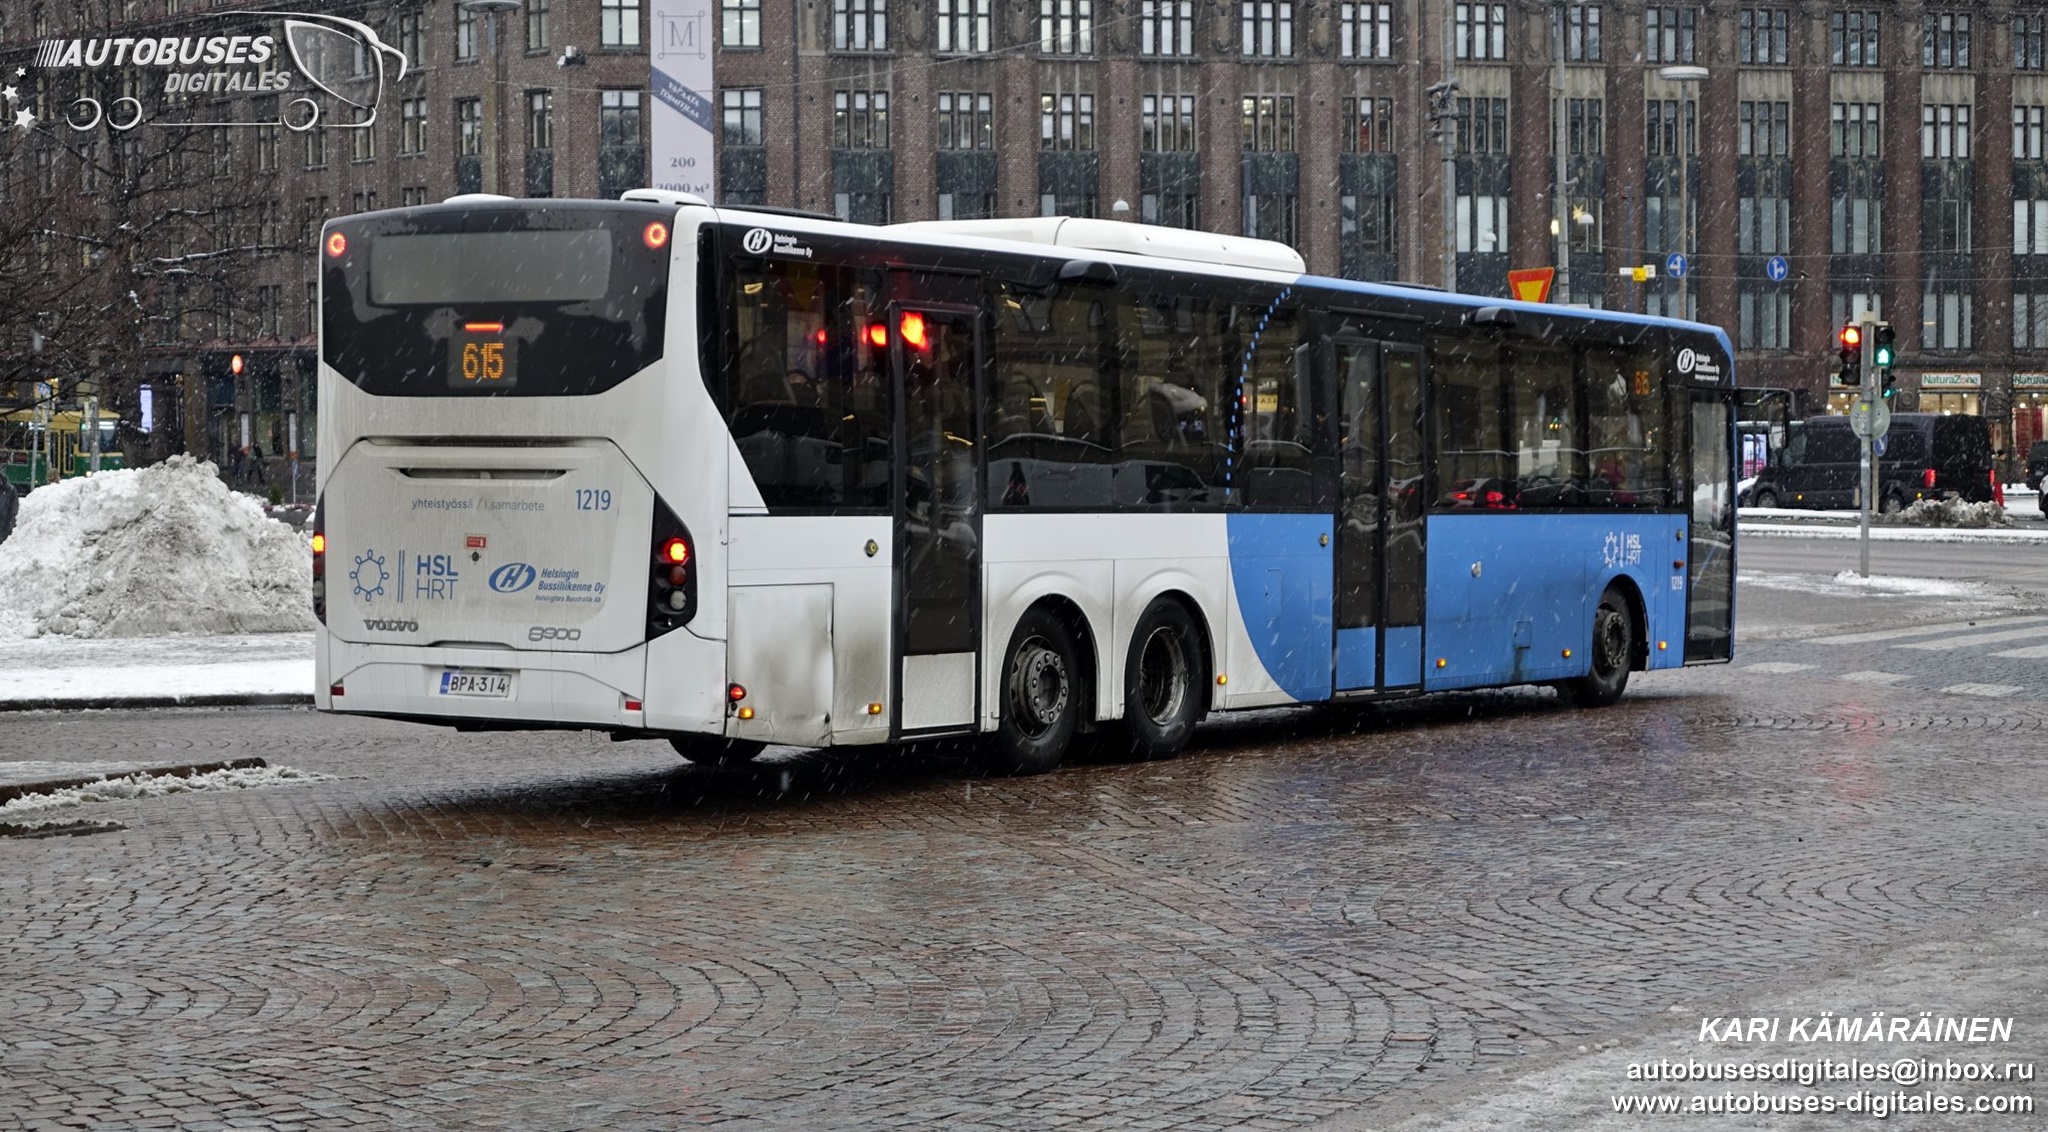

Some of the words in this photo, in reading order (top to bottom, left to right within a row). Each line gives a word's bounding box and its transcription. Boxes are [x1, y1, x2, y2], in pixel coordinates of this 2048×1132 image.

[669, 20, 695, 47] M
[670, 157, 696, 168] 200
[463, 343, 504, 379] 615
[1924, 373, 1979, 385] NaturaZone
[411, 498, 474, 510] yhteistyössä
[489, 501, 545, 511] samarbete
[576, 489, 611, 511] 1219
[1626, 534, 1642, 549] HSL
[1626, 549, 1642, 565] HRT
[417, 555, 458, 576] HSL
[541, 568, 579, 581] Helsingin
[416, 578, 458, 600] HRT
[538, 581, 592, 592] Bussiliikenne
[594, 581, 605, 594] Oy
[1671, 576, 1683, 590] 1219
[363, 619, 419, 632] VOLVO
[528, 626, 581, 641] 8900
